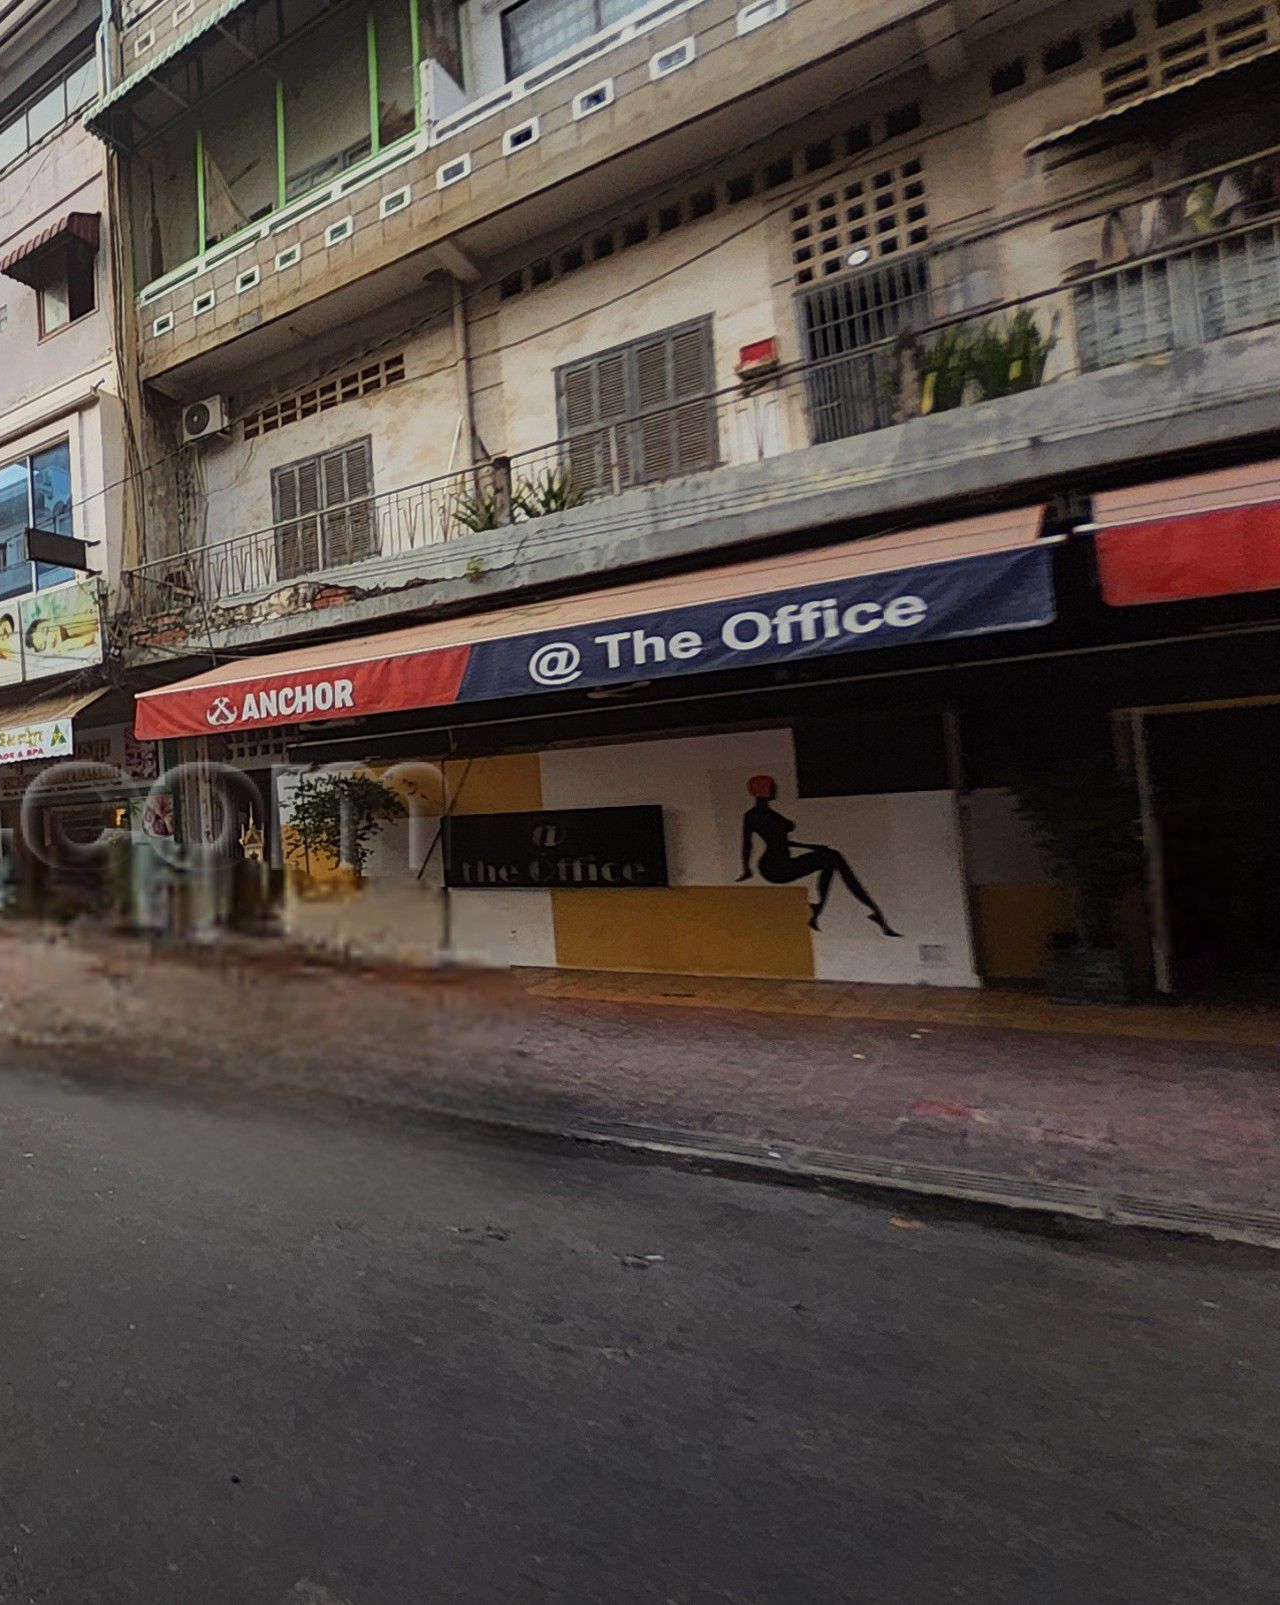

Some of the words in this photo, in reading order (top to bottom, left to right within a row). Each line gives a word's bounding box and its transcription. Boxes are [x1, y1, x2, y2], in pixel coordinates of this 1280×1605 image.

[528, 642, 582, 685] @
[595, 629, 703, 668] The
[722, 595, 928, 650] Office
[241, 679, 354, 721] ANCHOR
[26, 747, 45, 757] SPA
[461, 860, 519, 883] the
[528, 855, 647, 883] Office
